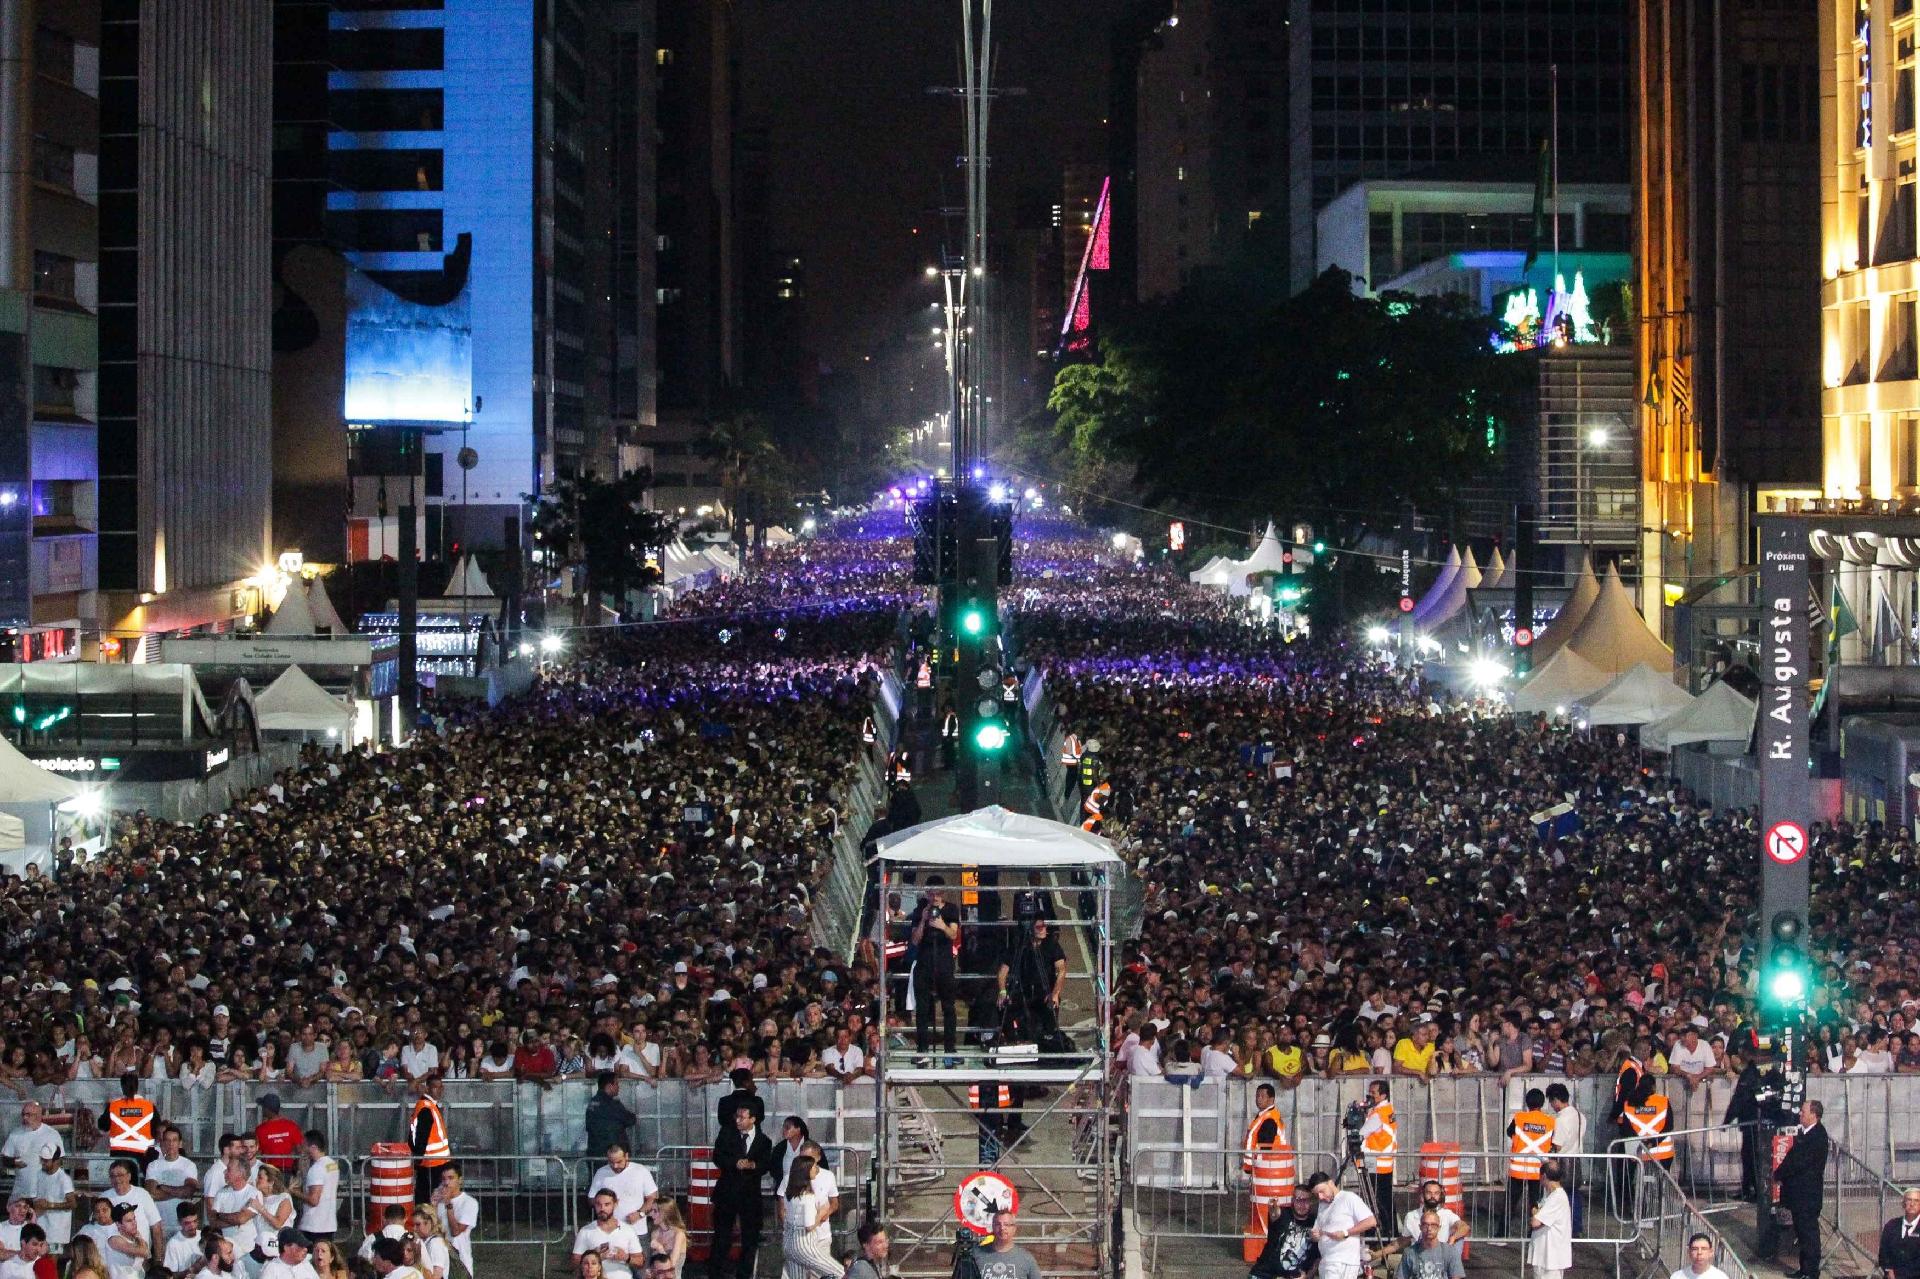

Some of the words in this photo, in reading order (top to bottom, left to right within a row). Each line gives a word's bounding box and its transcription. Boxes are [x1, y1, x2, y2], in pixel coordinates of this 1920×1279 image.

[1402, 549, 1410, 586] Augusta
[1766, 551, 1806, 561] Próxima
[1777, 564, 1795, 572] rua
[1769, 598, 1798, 724] Augusta
[1769, 734, 1792, 759] R.
